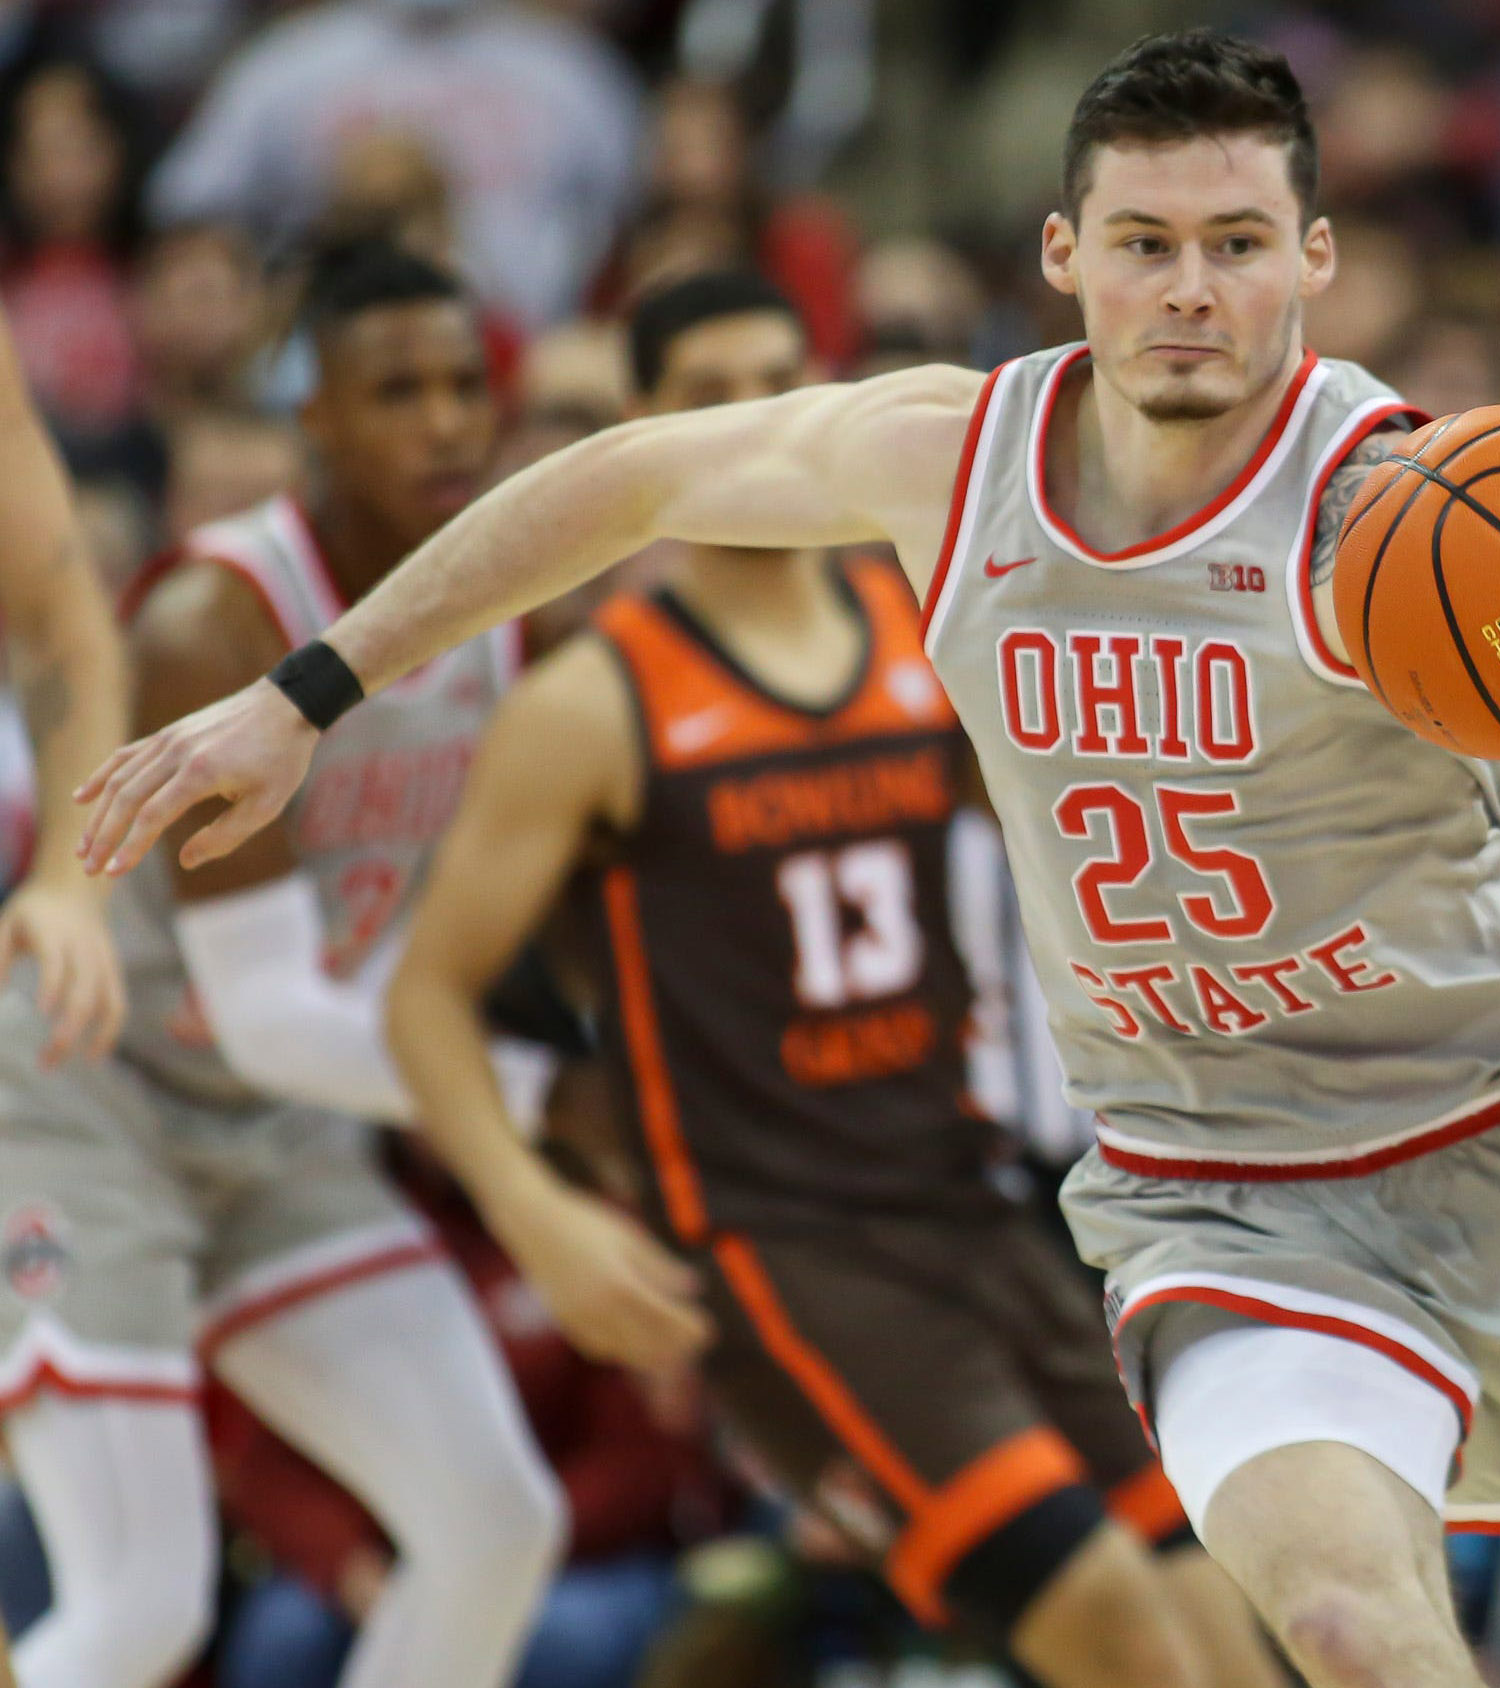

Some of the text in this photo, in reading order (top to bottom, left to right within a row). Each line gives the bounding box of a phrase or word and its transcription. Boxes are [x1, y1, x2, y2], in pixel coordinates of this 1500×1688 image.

[996, 626, 1259, 765] OHIO
[776, 838, 927, 1010] 13
[1052, 782, 1275, 945] 25
[1068, 924, 1401, 1040] STATE
